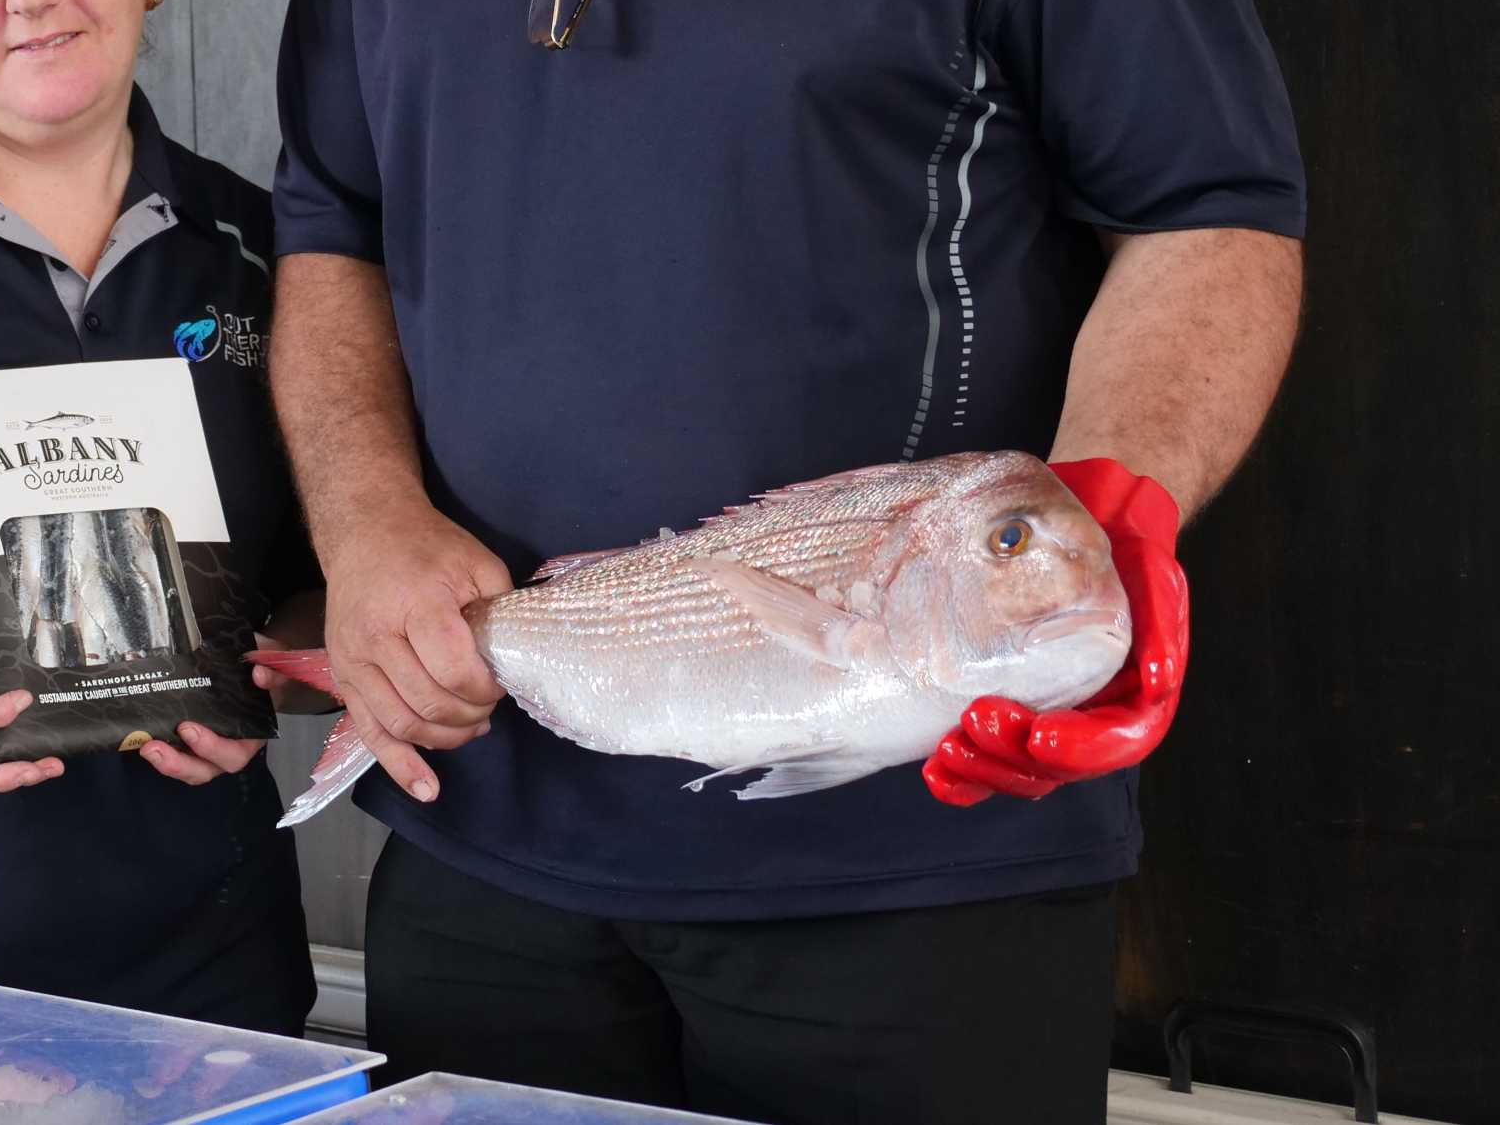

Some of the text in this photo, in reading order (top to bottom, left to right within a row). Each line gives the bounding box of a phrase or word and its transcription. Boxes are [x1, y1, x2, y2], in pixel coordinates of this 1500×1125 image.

[24, 463, 124, 490] Sardines
[39, 691, 83, 704] SUSTAINABLY
[84, 688, 112, 700] CAUGHT
[128, 683, 150, 695] GREAT
[152, 679, 189, 692] SOUTHERN
[189, 677, 211, 688] OCEAN
[81, 671, 162, 687] SARDINOPS SAGAX
